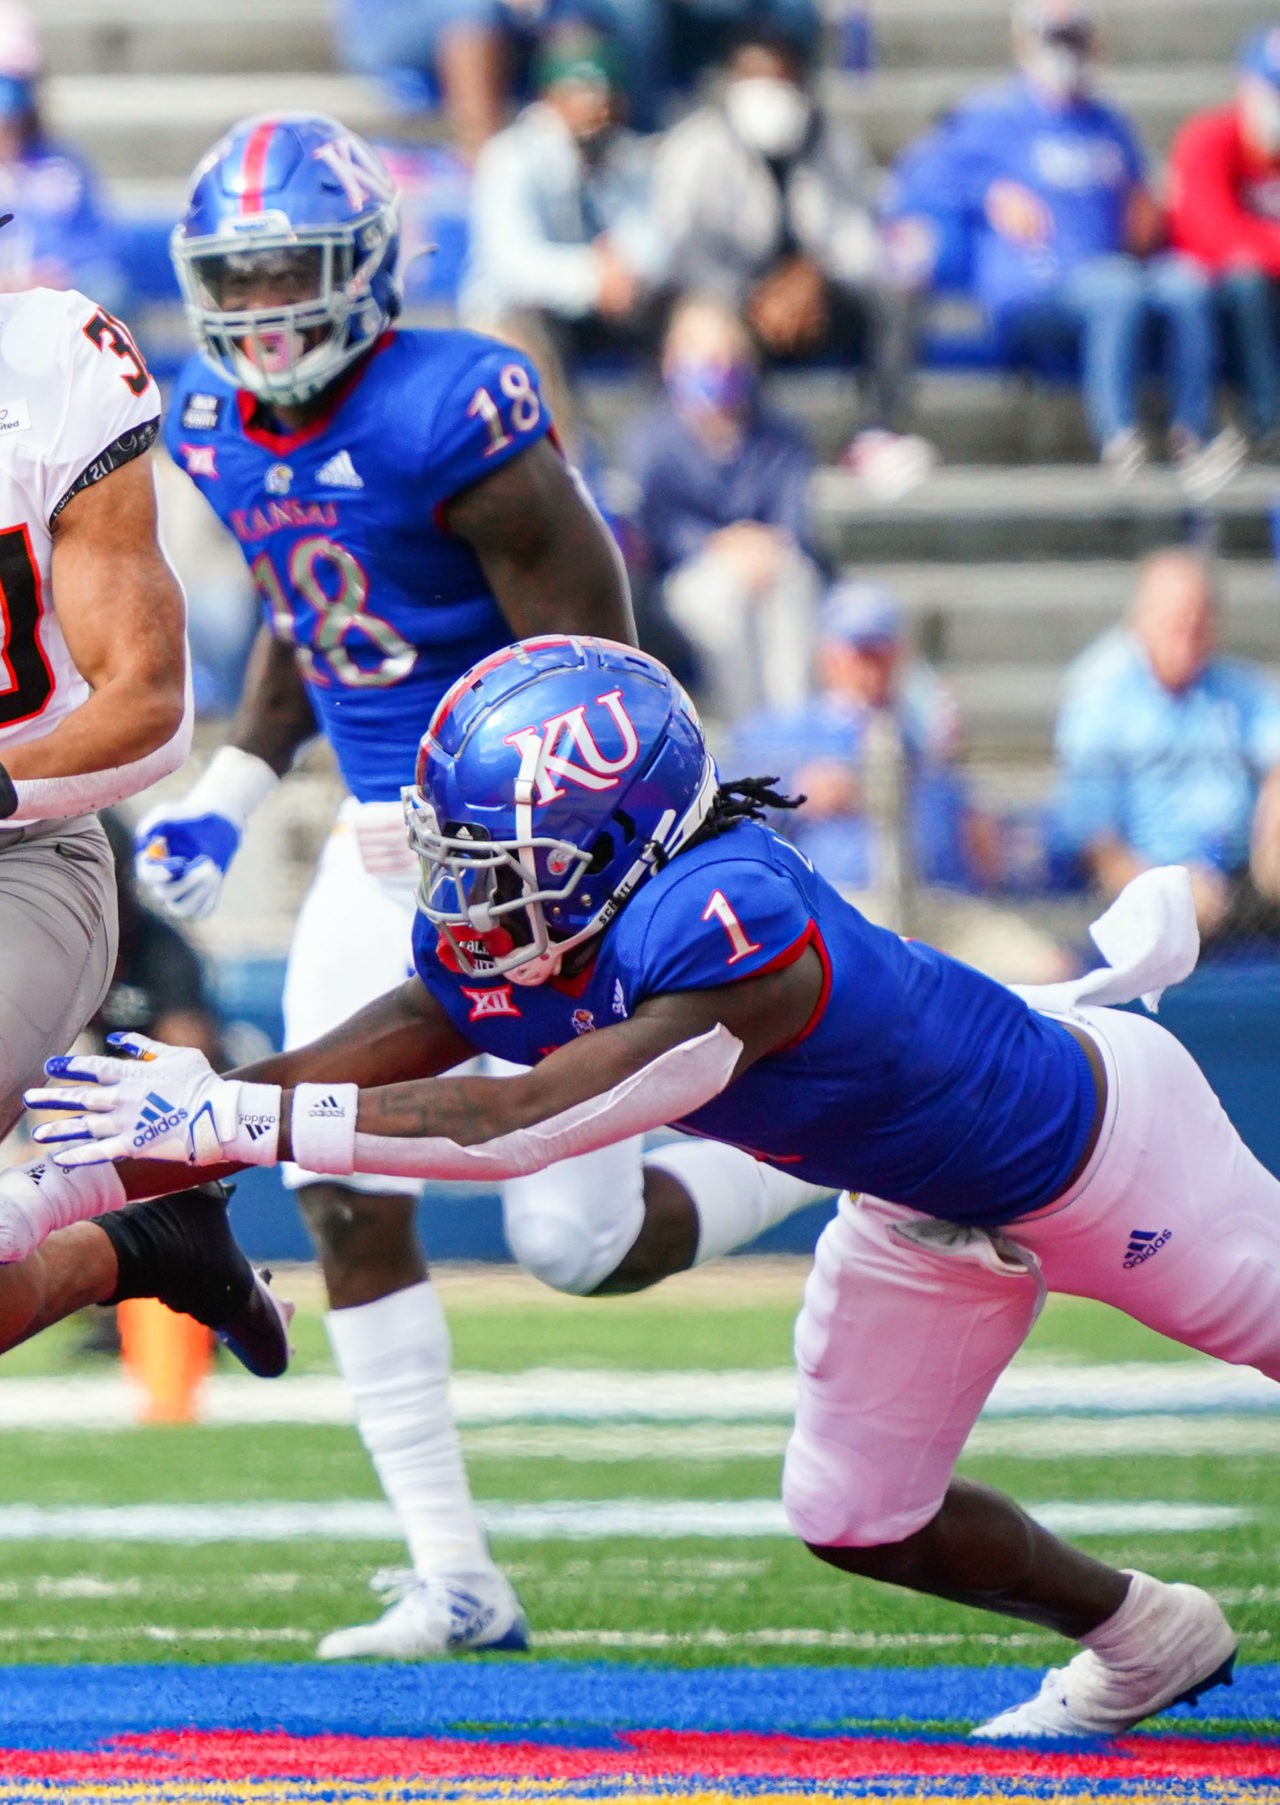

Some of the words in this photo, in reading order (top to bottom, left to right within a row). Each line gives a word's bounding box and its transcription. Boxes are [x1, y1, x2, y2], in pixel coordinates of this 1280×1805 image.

[82, 305, 154, 398] 3
[468, 362, 540, 458] 18
[251, 533, 418, 688] 18
[504, 690, 640, 807] KU
[702, 889, 761, 966] 1
[133, 1107, 189, 1148] adidas
[1122, 1228, 1172, 1270] adidas
